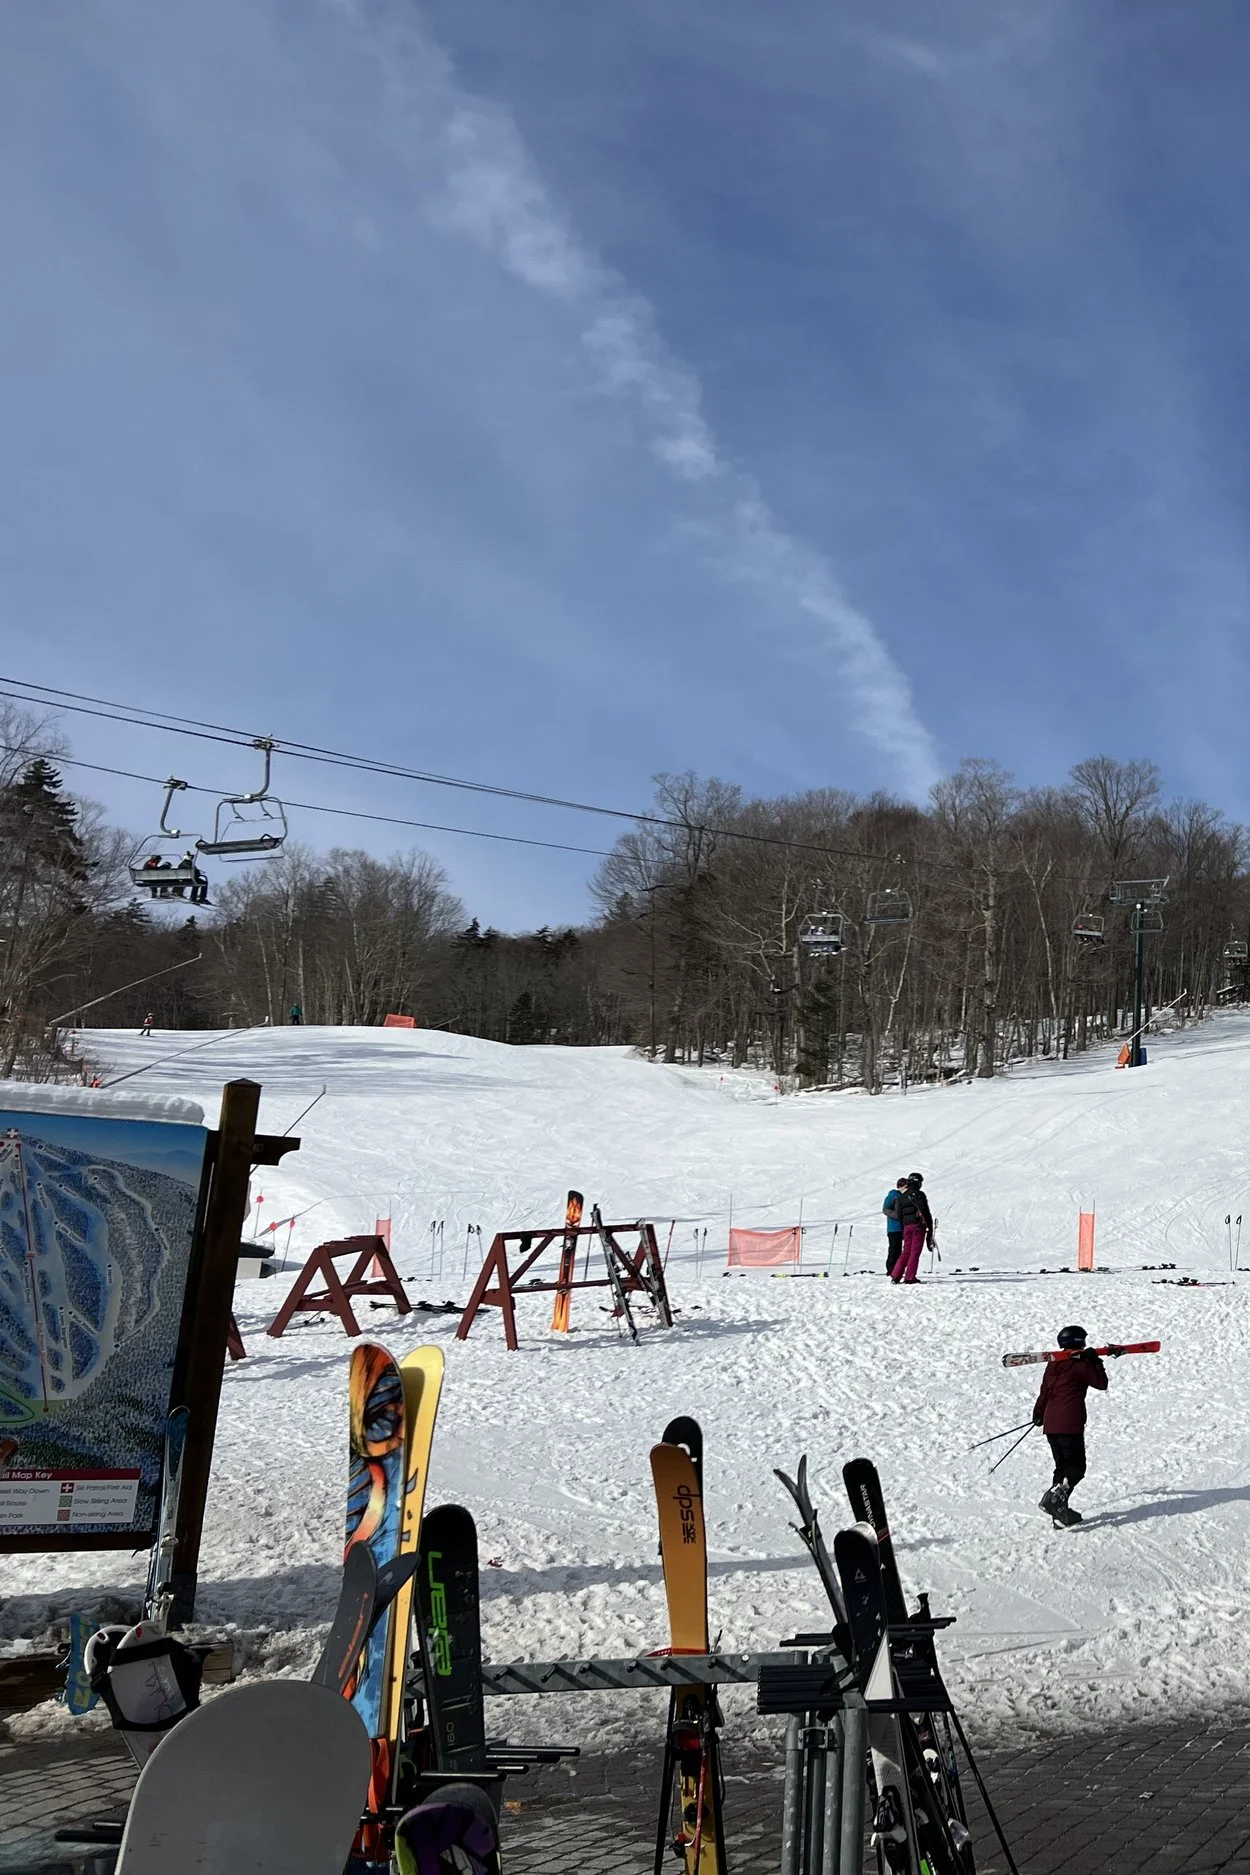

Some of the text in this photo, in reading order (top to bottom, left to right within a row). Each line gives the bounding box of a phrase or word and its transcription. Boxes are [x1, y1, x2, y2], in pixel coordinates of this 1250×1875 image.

[12, 1471, 33, 1480] Map
[35, 1471, 53, 1480] Key
[13, 1488, 28, 1496] Way
[29, 1487, 50, 1495] Down
